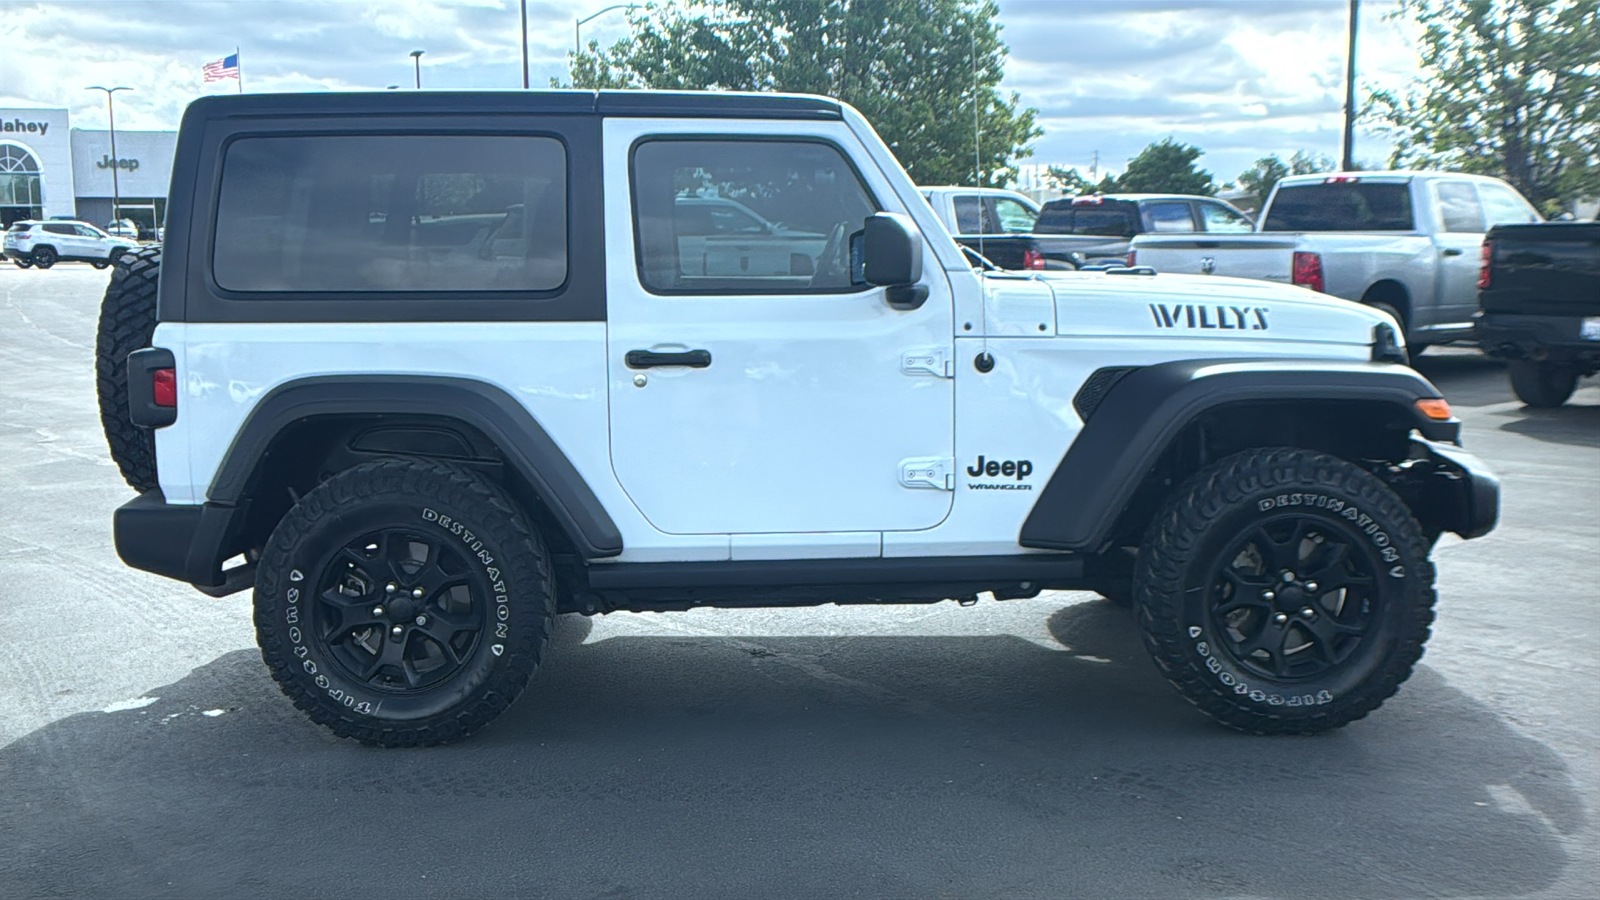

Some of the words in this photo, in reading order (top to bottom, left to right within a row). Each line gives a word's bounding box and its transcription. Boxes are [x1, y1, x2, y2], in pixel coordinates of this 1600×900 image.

[96, 155, 139, 172] Jeep
[1148, 303, 1269, 330] WILLYS
[967, 455, 1033, 481] Jeep
[1258, 493, 1400, 563] DESTINATION
[421, 508, 510, 638] DESTINATION
